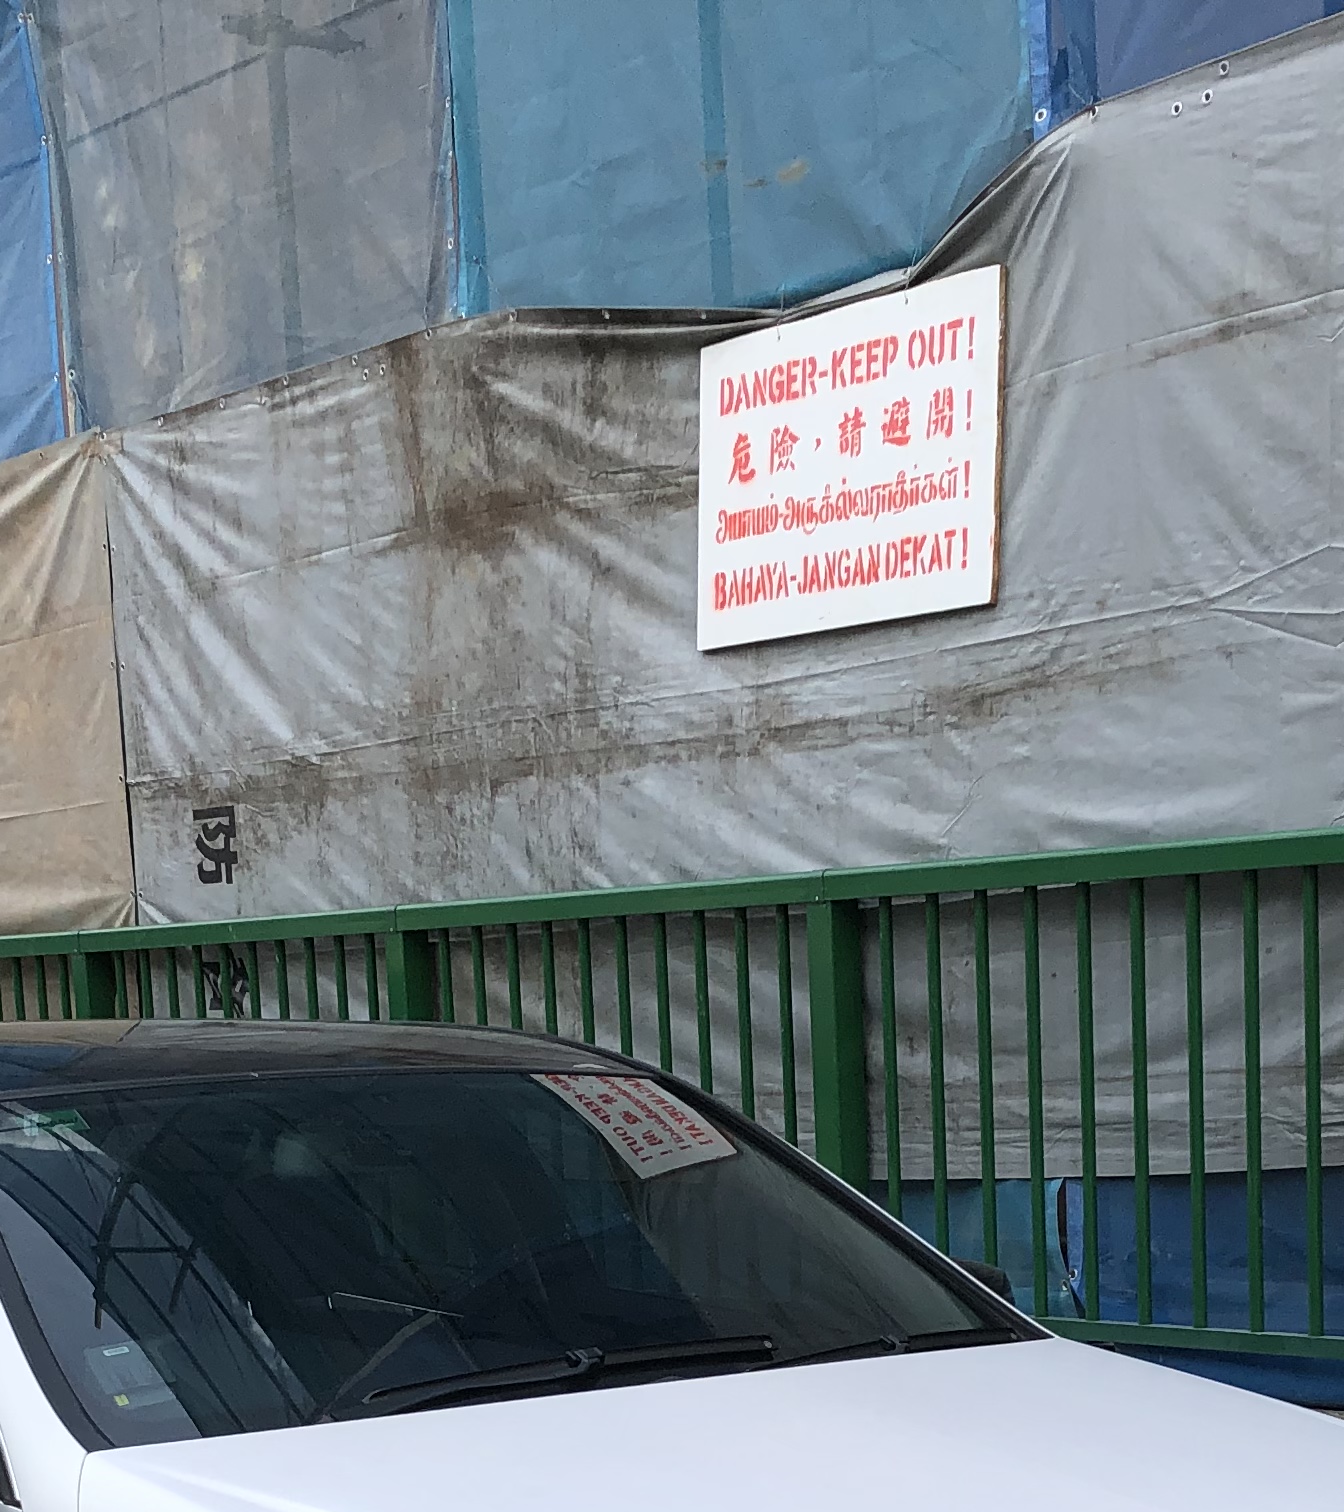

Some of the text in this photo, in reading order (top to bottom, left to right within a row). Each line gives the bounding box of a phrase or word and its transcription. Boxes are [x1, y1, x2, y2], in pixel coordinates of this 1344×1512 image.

[719, 316, 976, 417] DANGER-KEEP OUT!
[713, 527, 970, 612] BAHAYA-JANGAN DEKAT!
